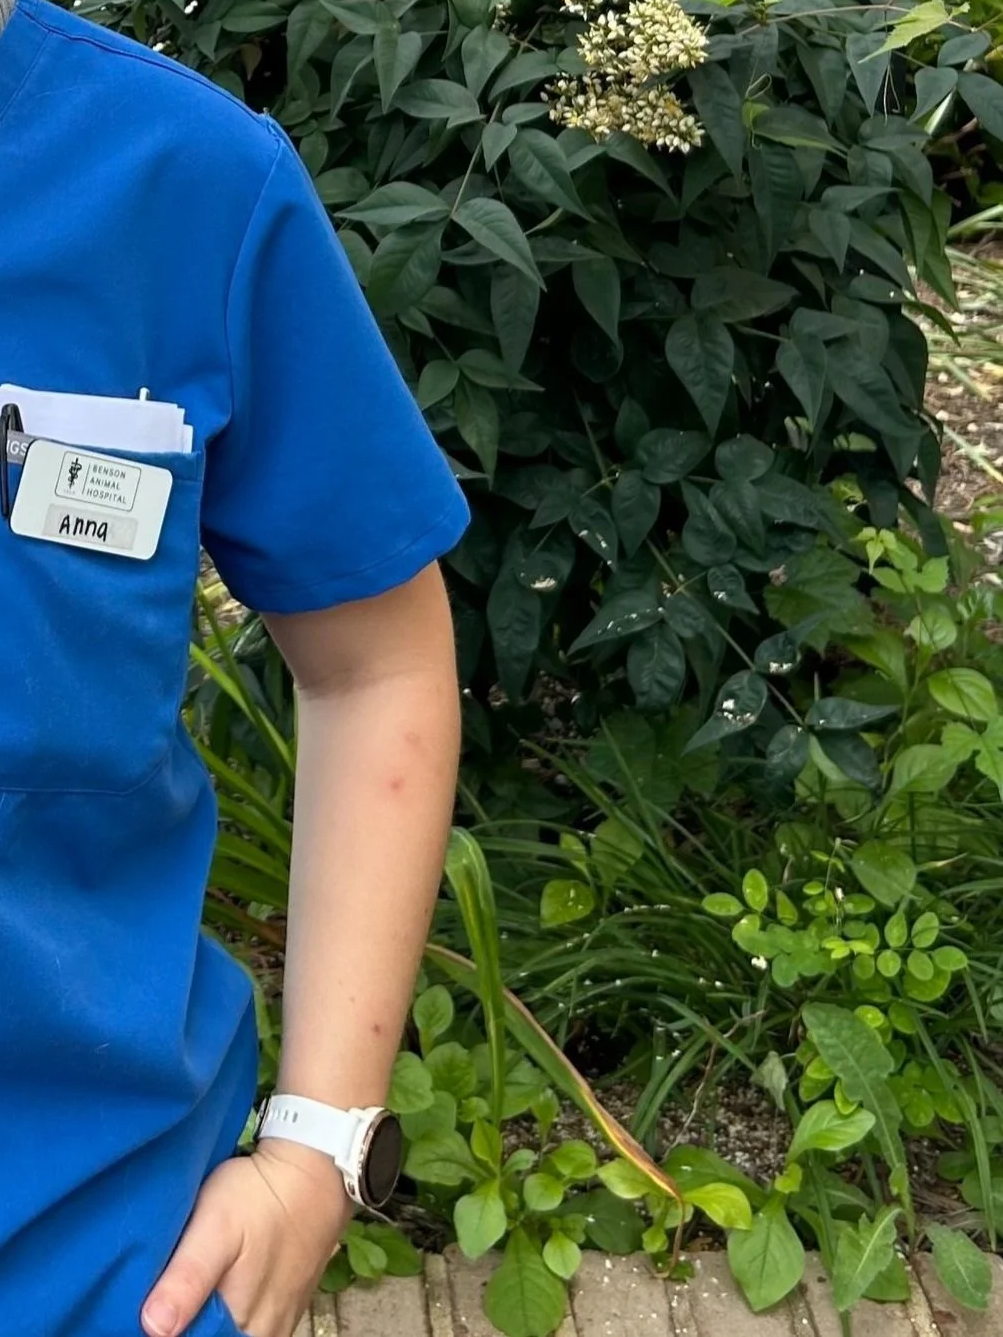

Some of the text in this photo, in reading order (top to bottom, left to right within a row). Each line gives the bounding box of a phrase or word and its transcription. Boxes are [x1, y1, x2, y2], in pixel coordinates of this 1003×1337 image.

[93, 465, 126, 478] BENSON
[90, 477, 120, 490] ANIMAL
[87, 488, 127, 504] HOSPITAL
[59, 515, 108, 542] Anna
